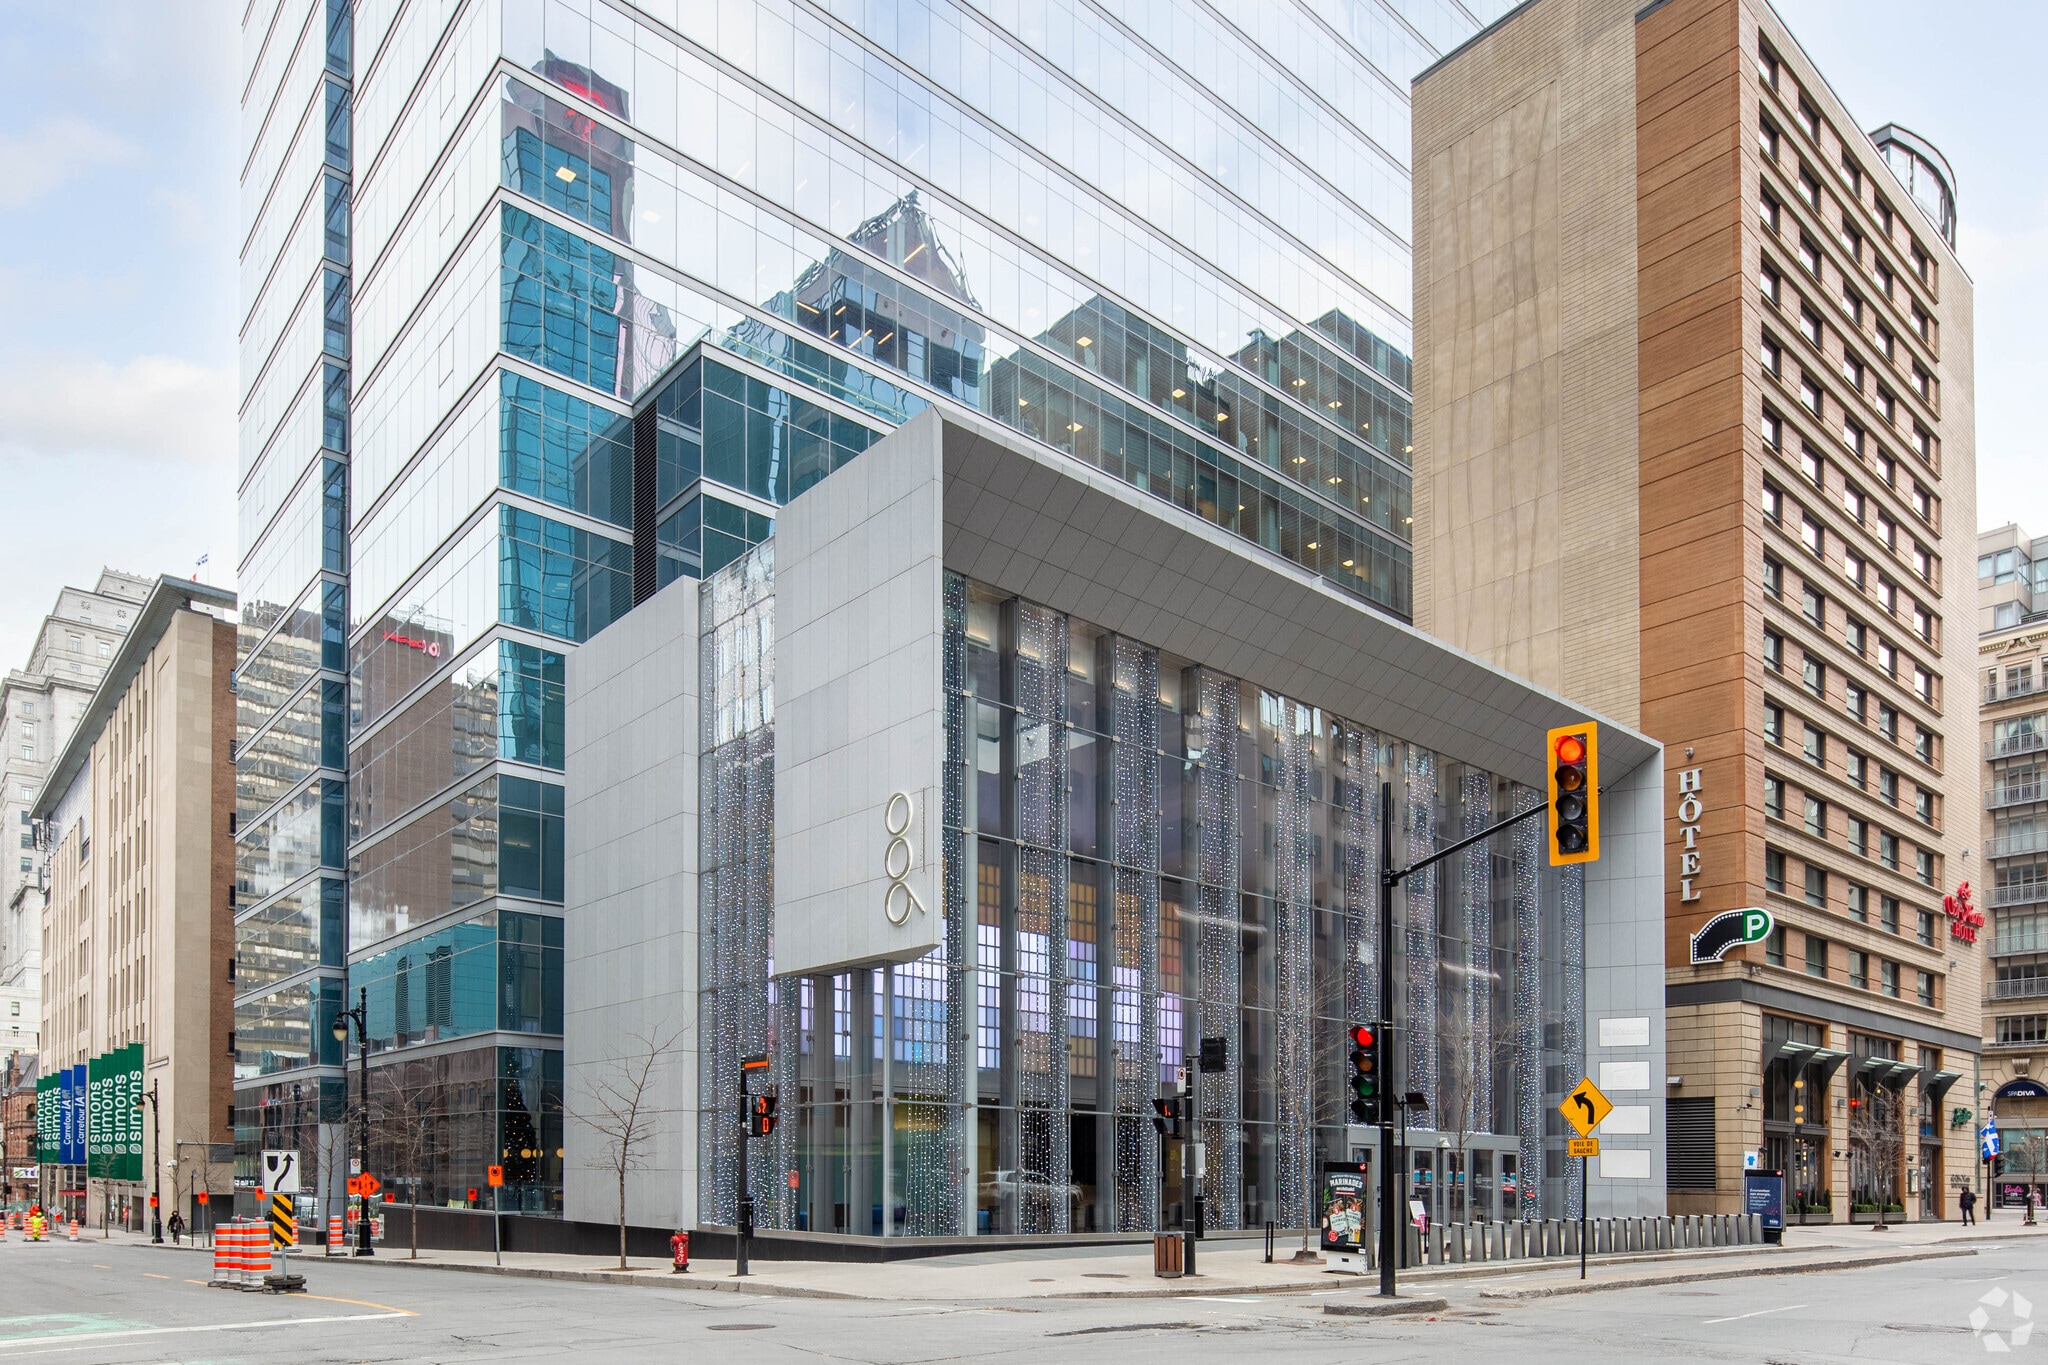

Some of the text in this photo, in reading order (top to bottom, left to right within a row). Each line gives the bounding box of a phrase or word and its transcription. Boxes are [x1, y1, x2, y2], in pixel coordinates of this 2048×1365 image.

[1677, 768, 1702, 901] HÔTEL
[1746, 913, 1765, 939] P
[44, 1089, 53, 1141] simons
[52, 1087, 61, 1140] simons
[63, 1110, 72, 1145] Carrefour
[77, 1108, 85, 1145] Carrefour
[90, 1081, 101, 1143] simons
[101, 1078, 114, 1143] simons
[114, 1074, 127, 1142] simons
[129, 1070, 142, 1142] simons
[1330, 1178, 1363, 1189] MARINADES
[2004, 1184, 2024, 1193] Barbie
